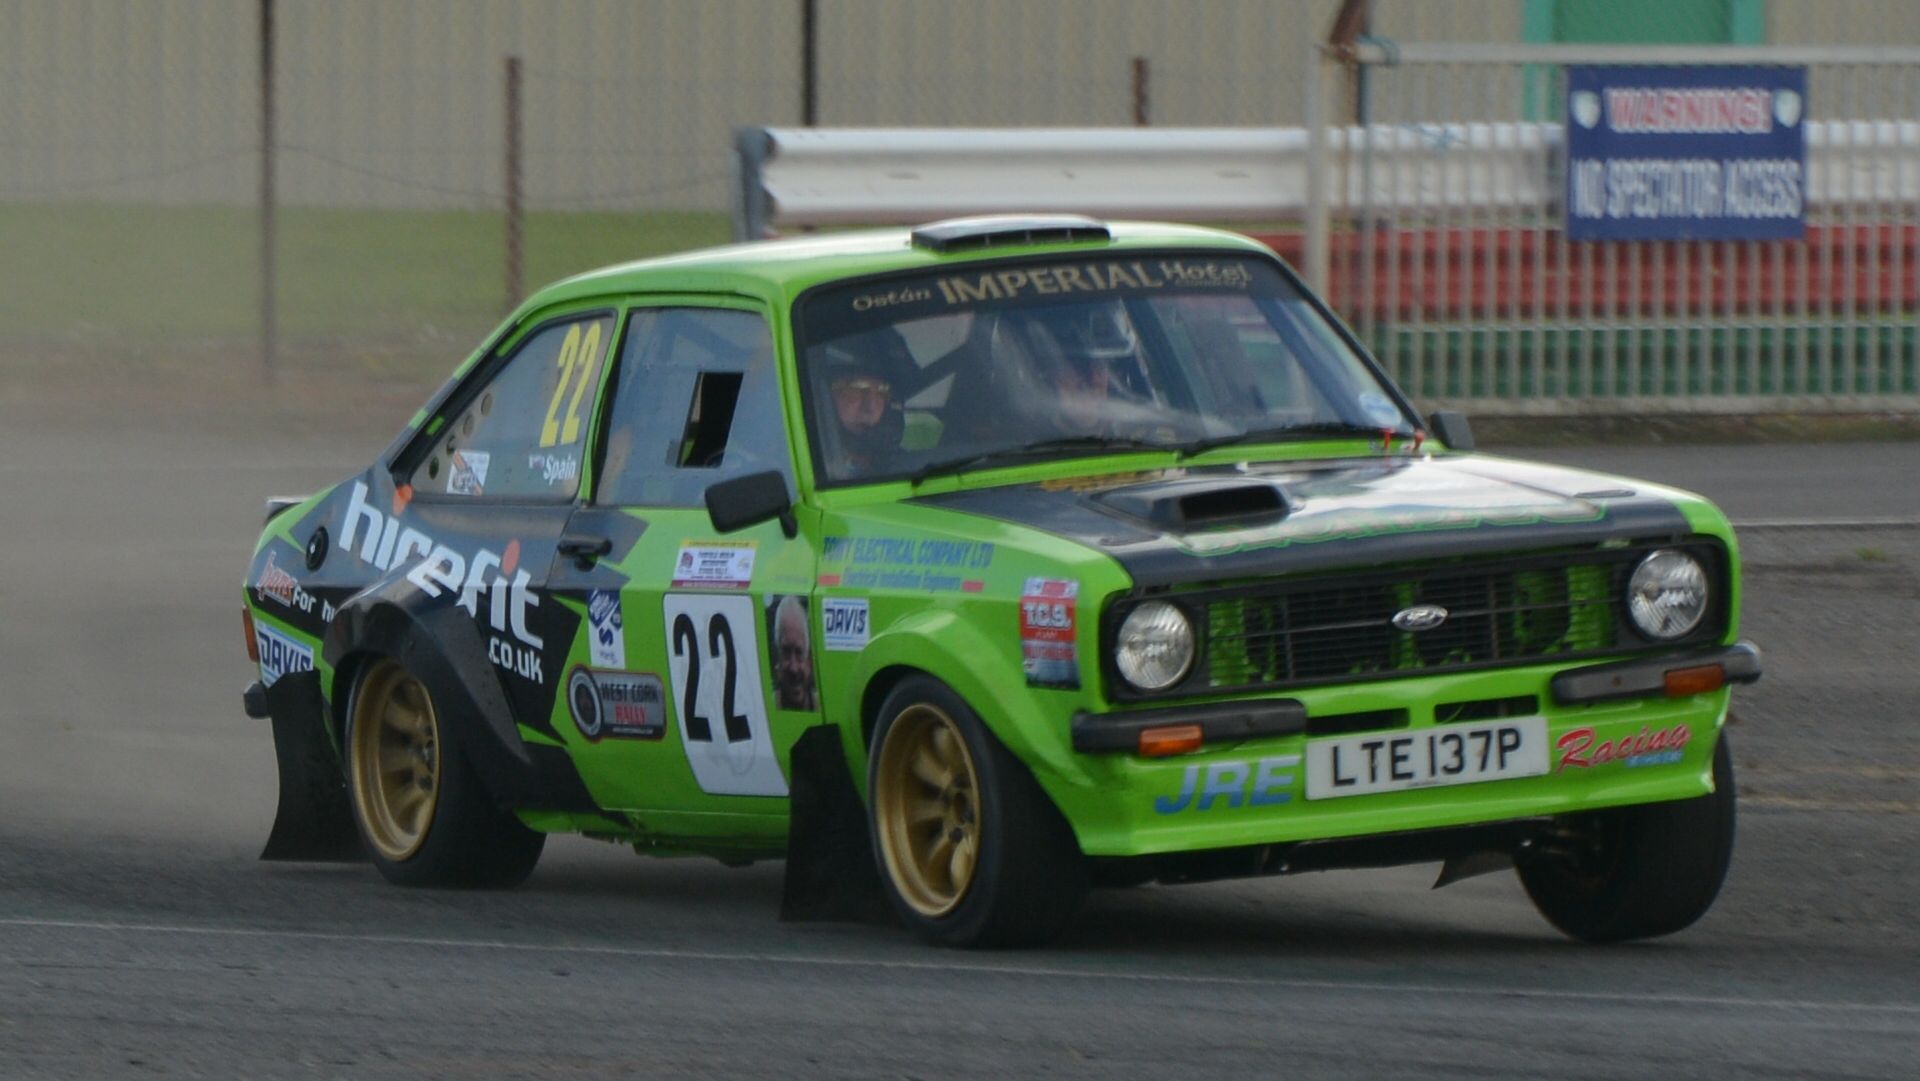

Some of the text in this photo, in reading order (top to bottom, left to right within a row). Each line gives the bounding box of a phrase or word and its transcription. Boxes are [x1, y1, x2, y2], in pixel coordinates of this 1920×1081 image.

[1571, 157, 1801, 219] NO SPECTATOR ACCESS
[937, 260, 1164, 305] IMPERIAL
[1159, 260, 1253, 282] Hotel
[539, 321, 601, 448] 22
[543, 454, 577, 486] Spain
[853, 538, 917, 565] ELECTRICAL
[918, 540, 973, 567] COMPANY
[970, 543, 995, 569] LTD
[824, 607, 867, 635] DAVIS
[601, 682, 628, 702] WEST
[673, 612, 752, 743] 22
[1330, 727, 1522, 787] LTE 137P
[1556, 724, 1691, 776] Racing
[1154, 754, 1301, 816] JRE
